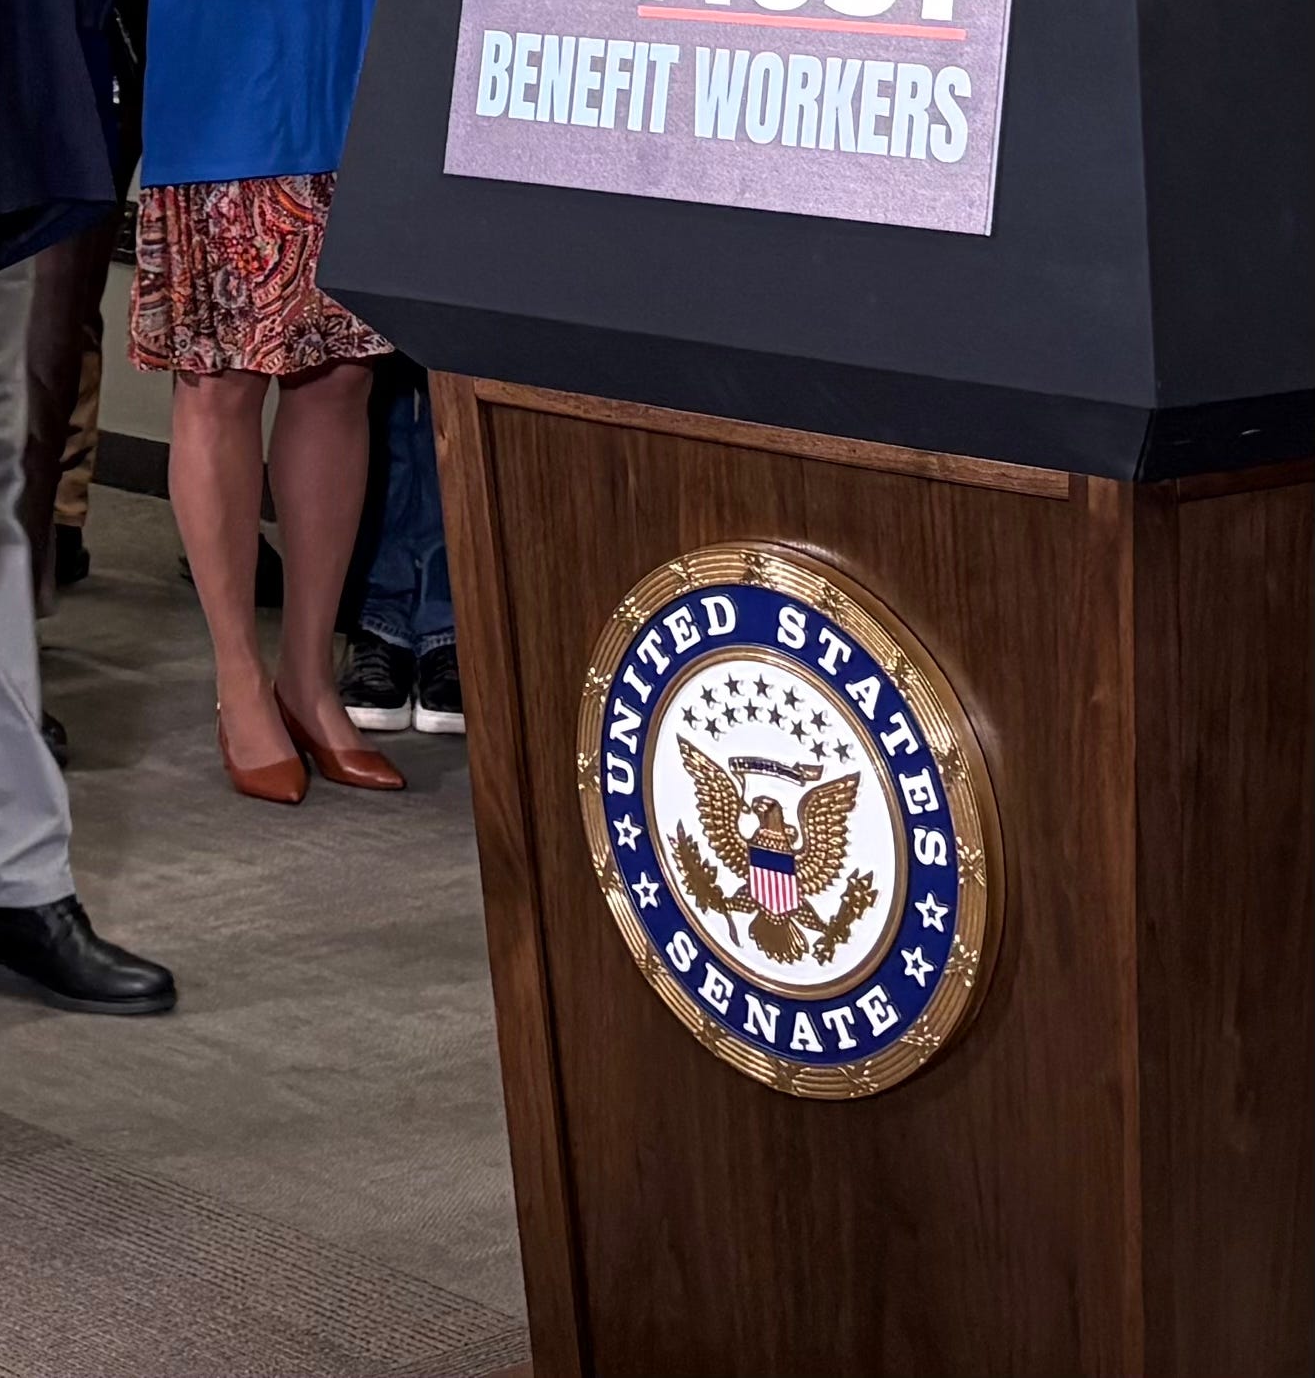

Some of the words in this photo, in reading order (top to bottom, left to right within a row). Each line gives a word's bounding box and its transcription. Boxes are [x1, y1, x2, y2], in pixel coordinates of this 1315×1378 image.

[475, 28, 681, 134] BENEFIT
[694, 45, 973, 165] WORKERS
[606, 594, 737, 796] UNITED
[776, 605, 949, 868] STATES
[665, 929, 900, 1054] SENATE
